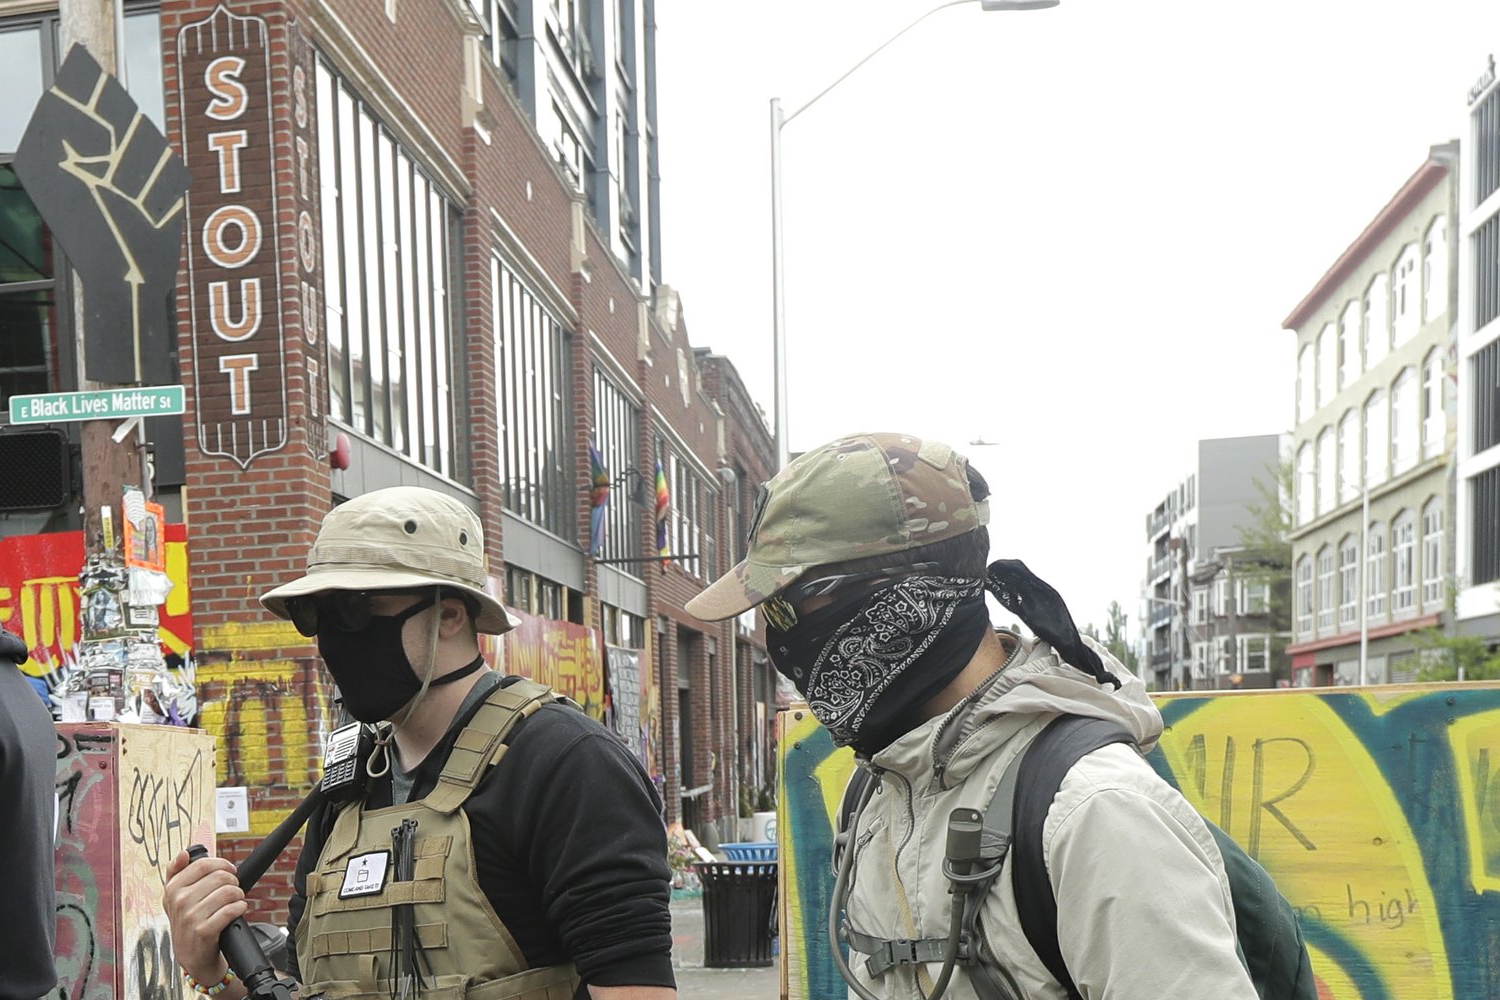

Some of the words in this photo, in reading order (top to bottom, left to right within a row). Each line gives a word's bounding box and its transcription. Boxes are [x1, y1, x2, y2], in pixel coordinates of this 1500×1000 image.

[202, 56, 263, 415] STOUT
[21, 406, 28, 418] E
[31, 396, 68, 417] Black
[72, 395, 108, 414] Lives
[112, 392, 156, 411] Matter
[159, 395, 171, 409] St
